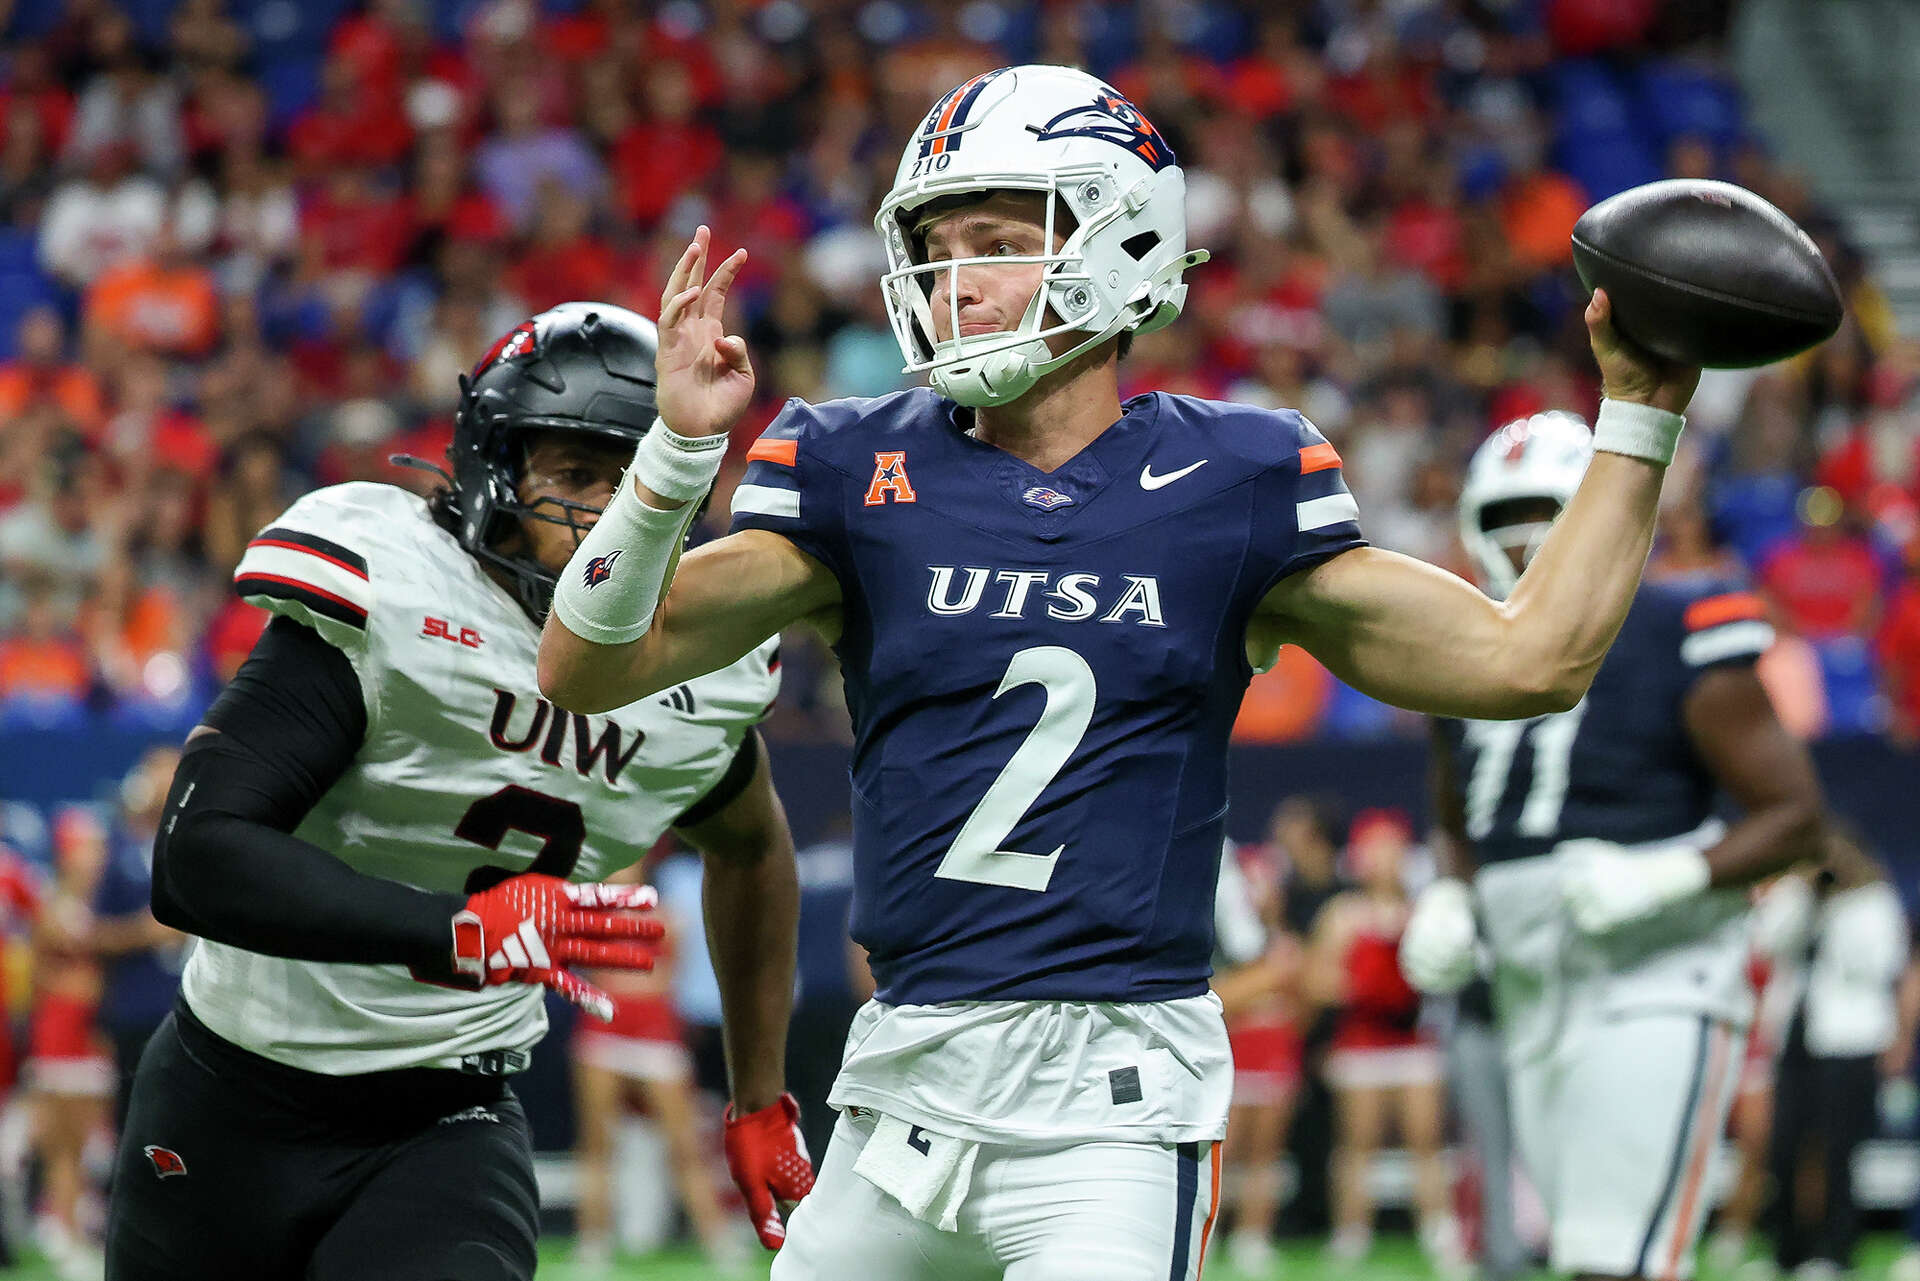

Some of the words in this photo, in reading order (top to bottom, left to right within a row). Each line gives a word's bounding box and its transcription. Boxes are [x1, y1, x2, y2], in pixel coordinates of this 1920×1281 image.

[909, 153, 951, 180] 210
[926, 564, 1167, 628] UTSA
[491, 688, 645, 784] UIW
[934, 645, 1096, 892] 2
